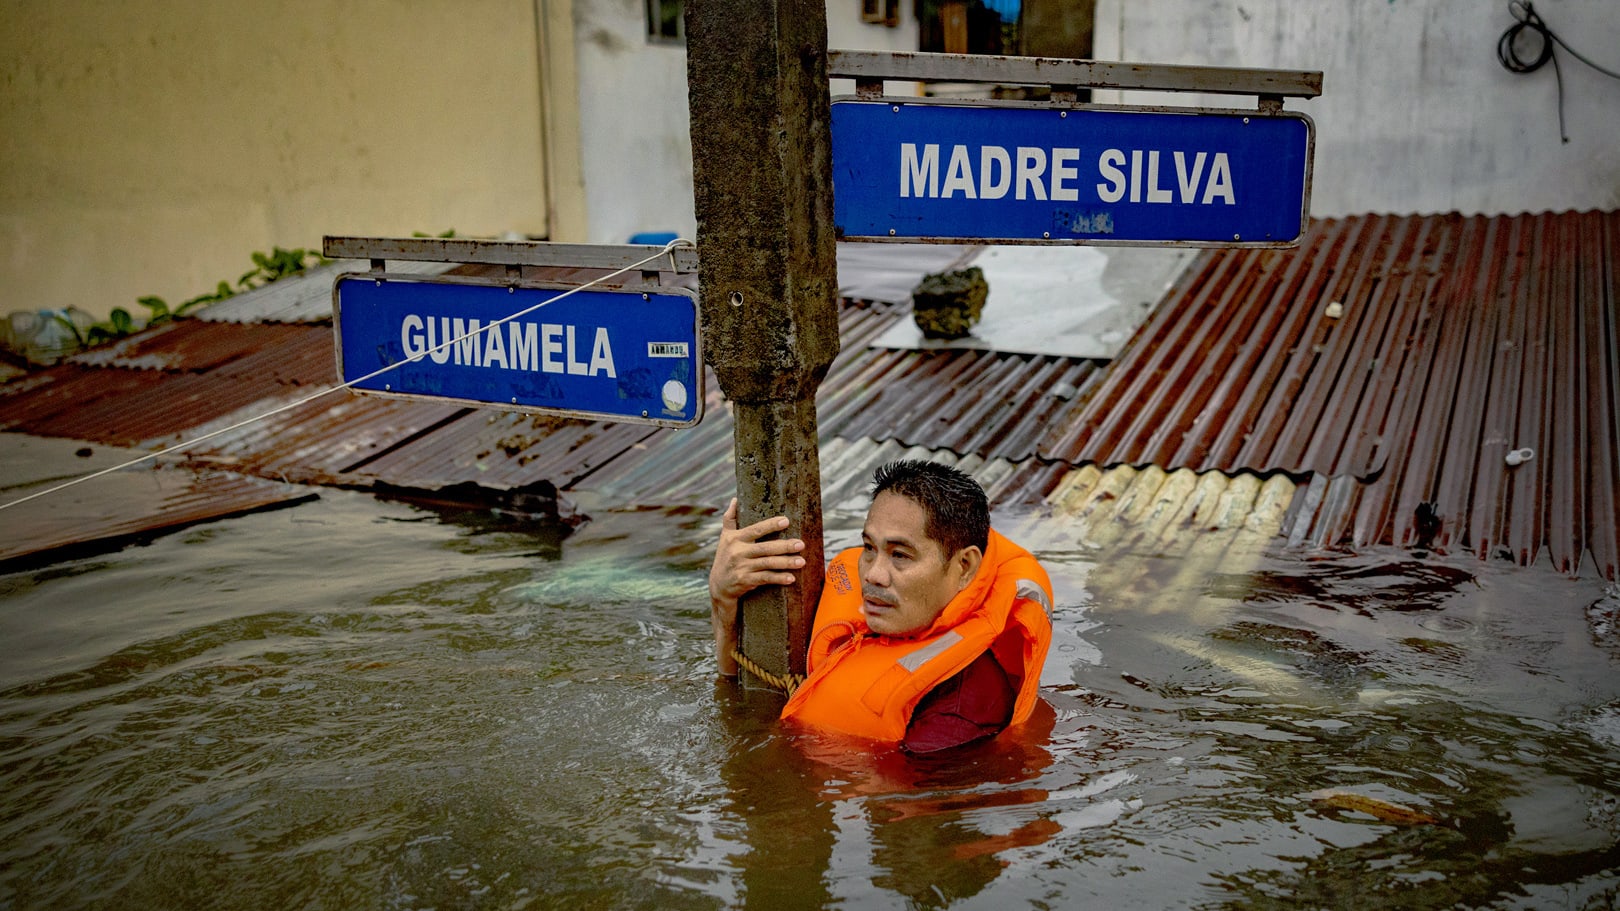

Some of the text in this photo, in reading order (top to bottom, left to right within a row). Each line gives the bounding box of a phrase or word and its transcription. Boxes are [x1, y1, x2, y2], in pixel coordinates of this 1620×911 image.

[900, 143, 1236, 205] MADRE SILVA
[402, 314, 616, 378] GUMAMELA
